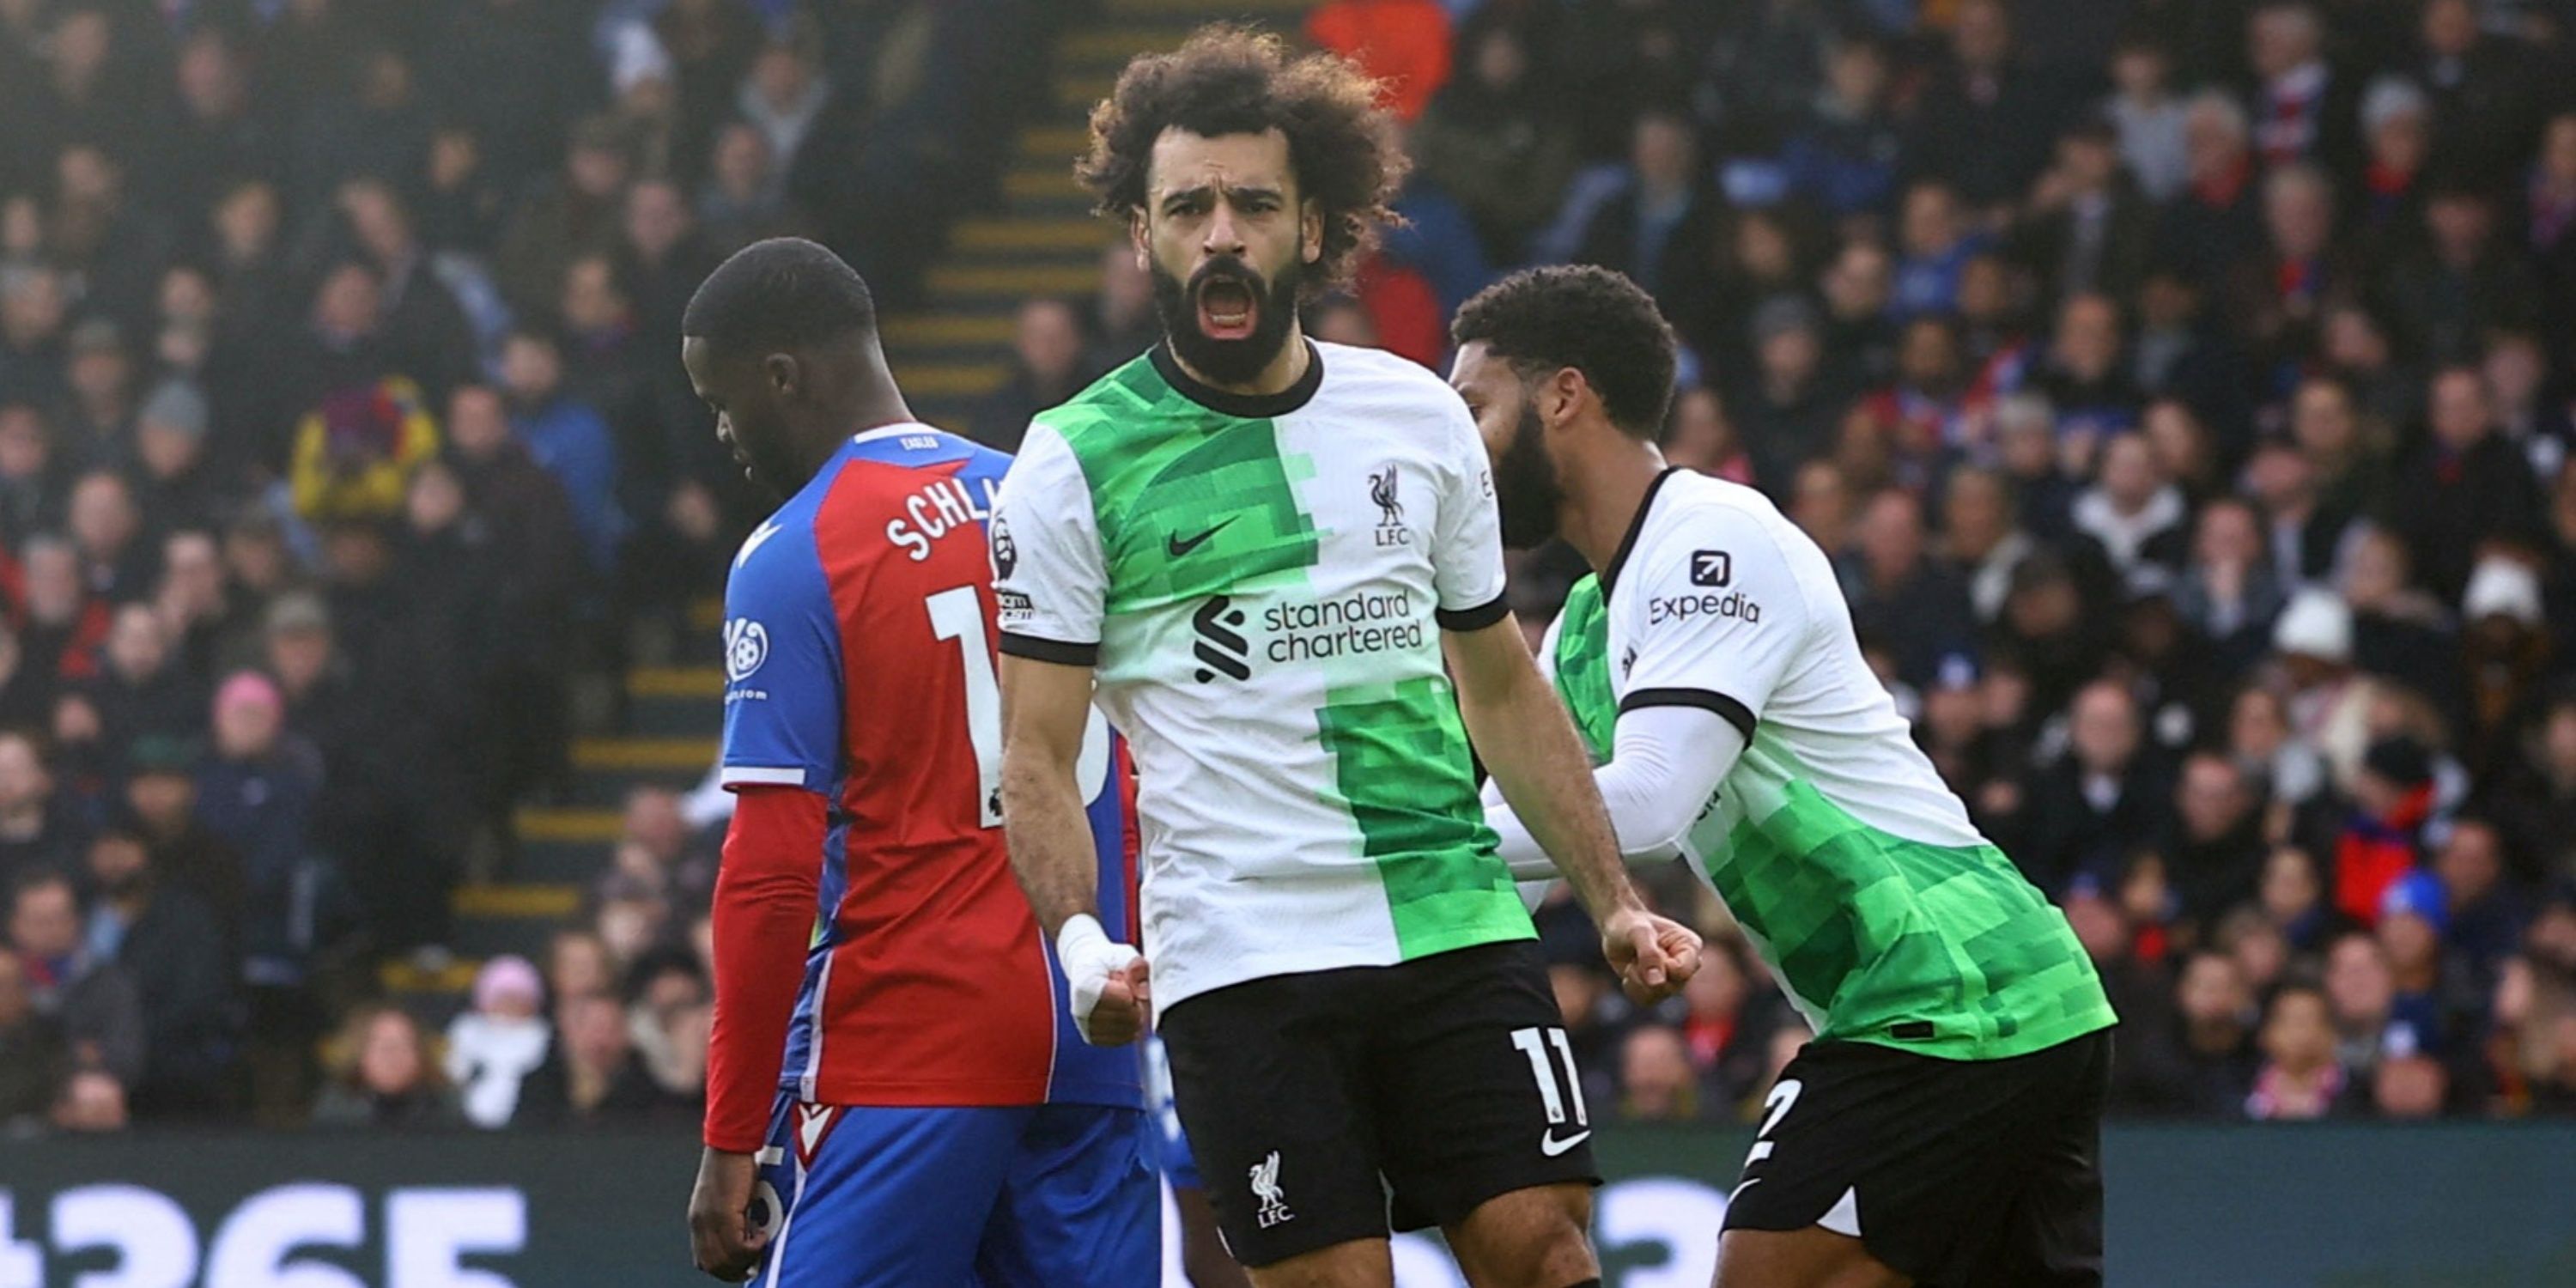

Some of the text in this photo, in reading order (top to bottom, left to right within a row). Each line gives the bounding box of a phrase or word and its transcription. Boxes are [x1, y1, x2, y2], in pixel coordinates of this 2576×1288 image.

[1265, 589, 1410, 632] standard
[1649, 592, 1760, 625] Expedia
[1267, 619, 1423, 662] chartered
[1510, 1027, 1588, 1127] 11
